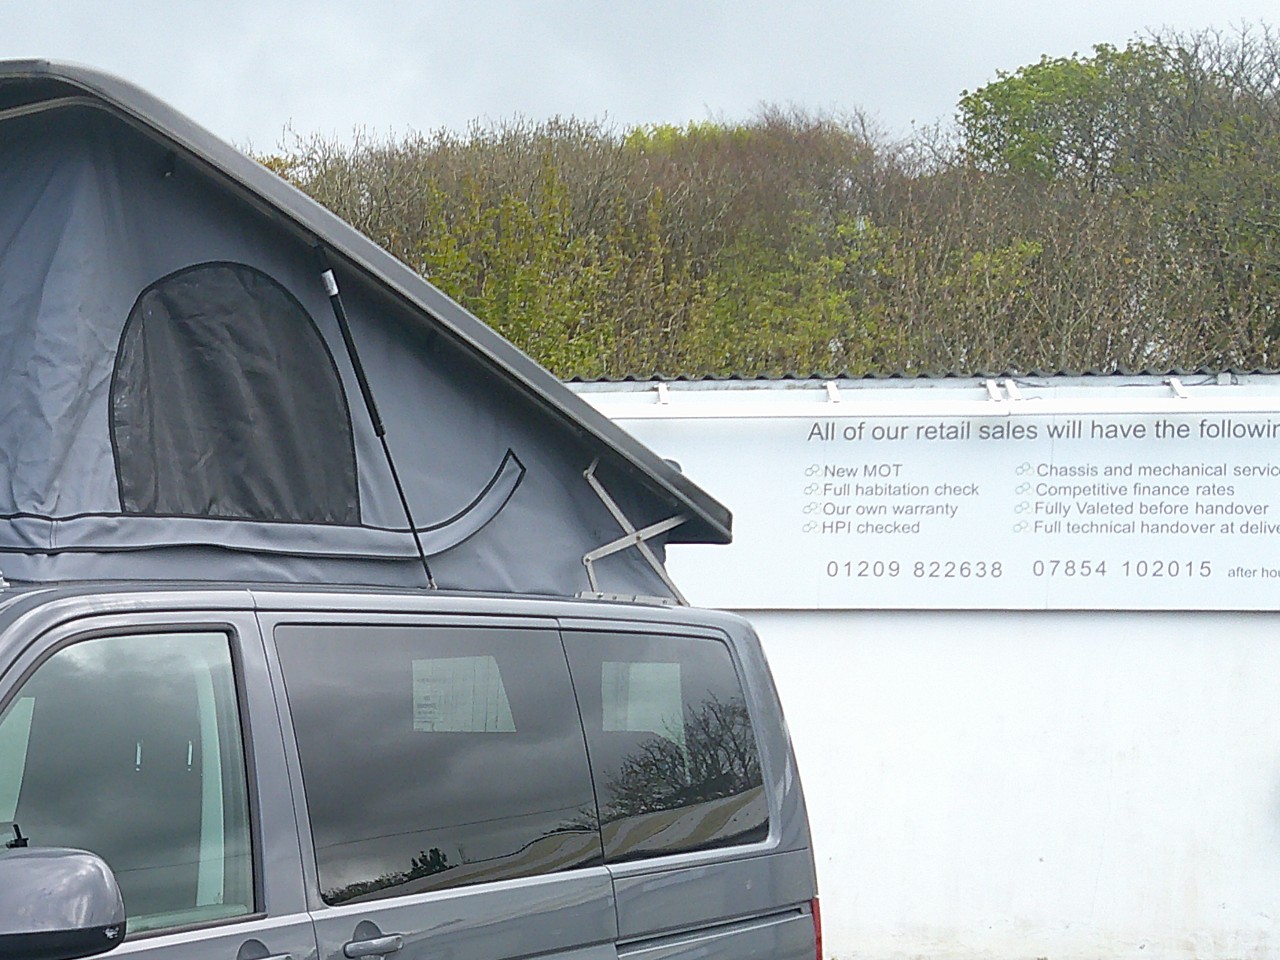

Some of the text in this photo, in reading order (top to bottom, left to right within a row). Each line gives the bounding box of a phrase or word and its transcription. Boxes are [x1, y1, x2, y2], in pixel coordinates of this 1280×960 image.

[807, 422, 835, 441] All
[843, 421, 864, 441] of
[872, 426, 909, 440] our
[916, 421, 971, 440] retail
[978, 421, 1038, 440] sales
[1046, 420, 1082, 440] will
[1090, 420, 1147, 440] have
[1155, 419, 1191, 439] the
[824, 464, 903, 477] New MOT
[1036, 463, 1280, 477] Chassis and mechanical servic
[823, 483, 980, 496] Full habitation check
[1035, 482, 1235, 499] Competitive finance rates
[822, 502, 959, 518] Our own warranty
[1034, 501, 1269, 518] Fully Valeted before handover
[821, 520, 921, 534] HPI checked
[1034, 521, 1061, 534] Full
[1066, 520, 1136, 534] technical
[1141, 520, 1215, 534] handover
[1220, 522, 1235, 534] at
[826, 560, 901, 578] 01209
[913, 560, 1003, 578] 822638
[1032, 559, 1108, 577] 07854
[1122, 559, 1212, 577] 102015
[1227, 566, 1258, 578] after
